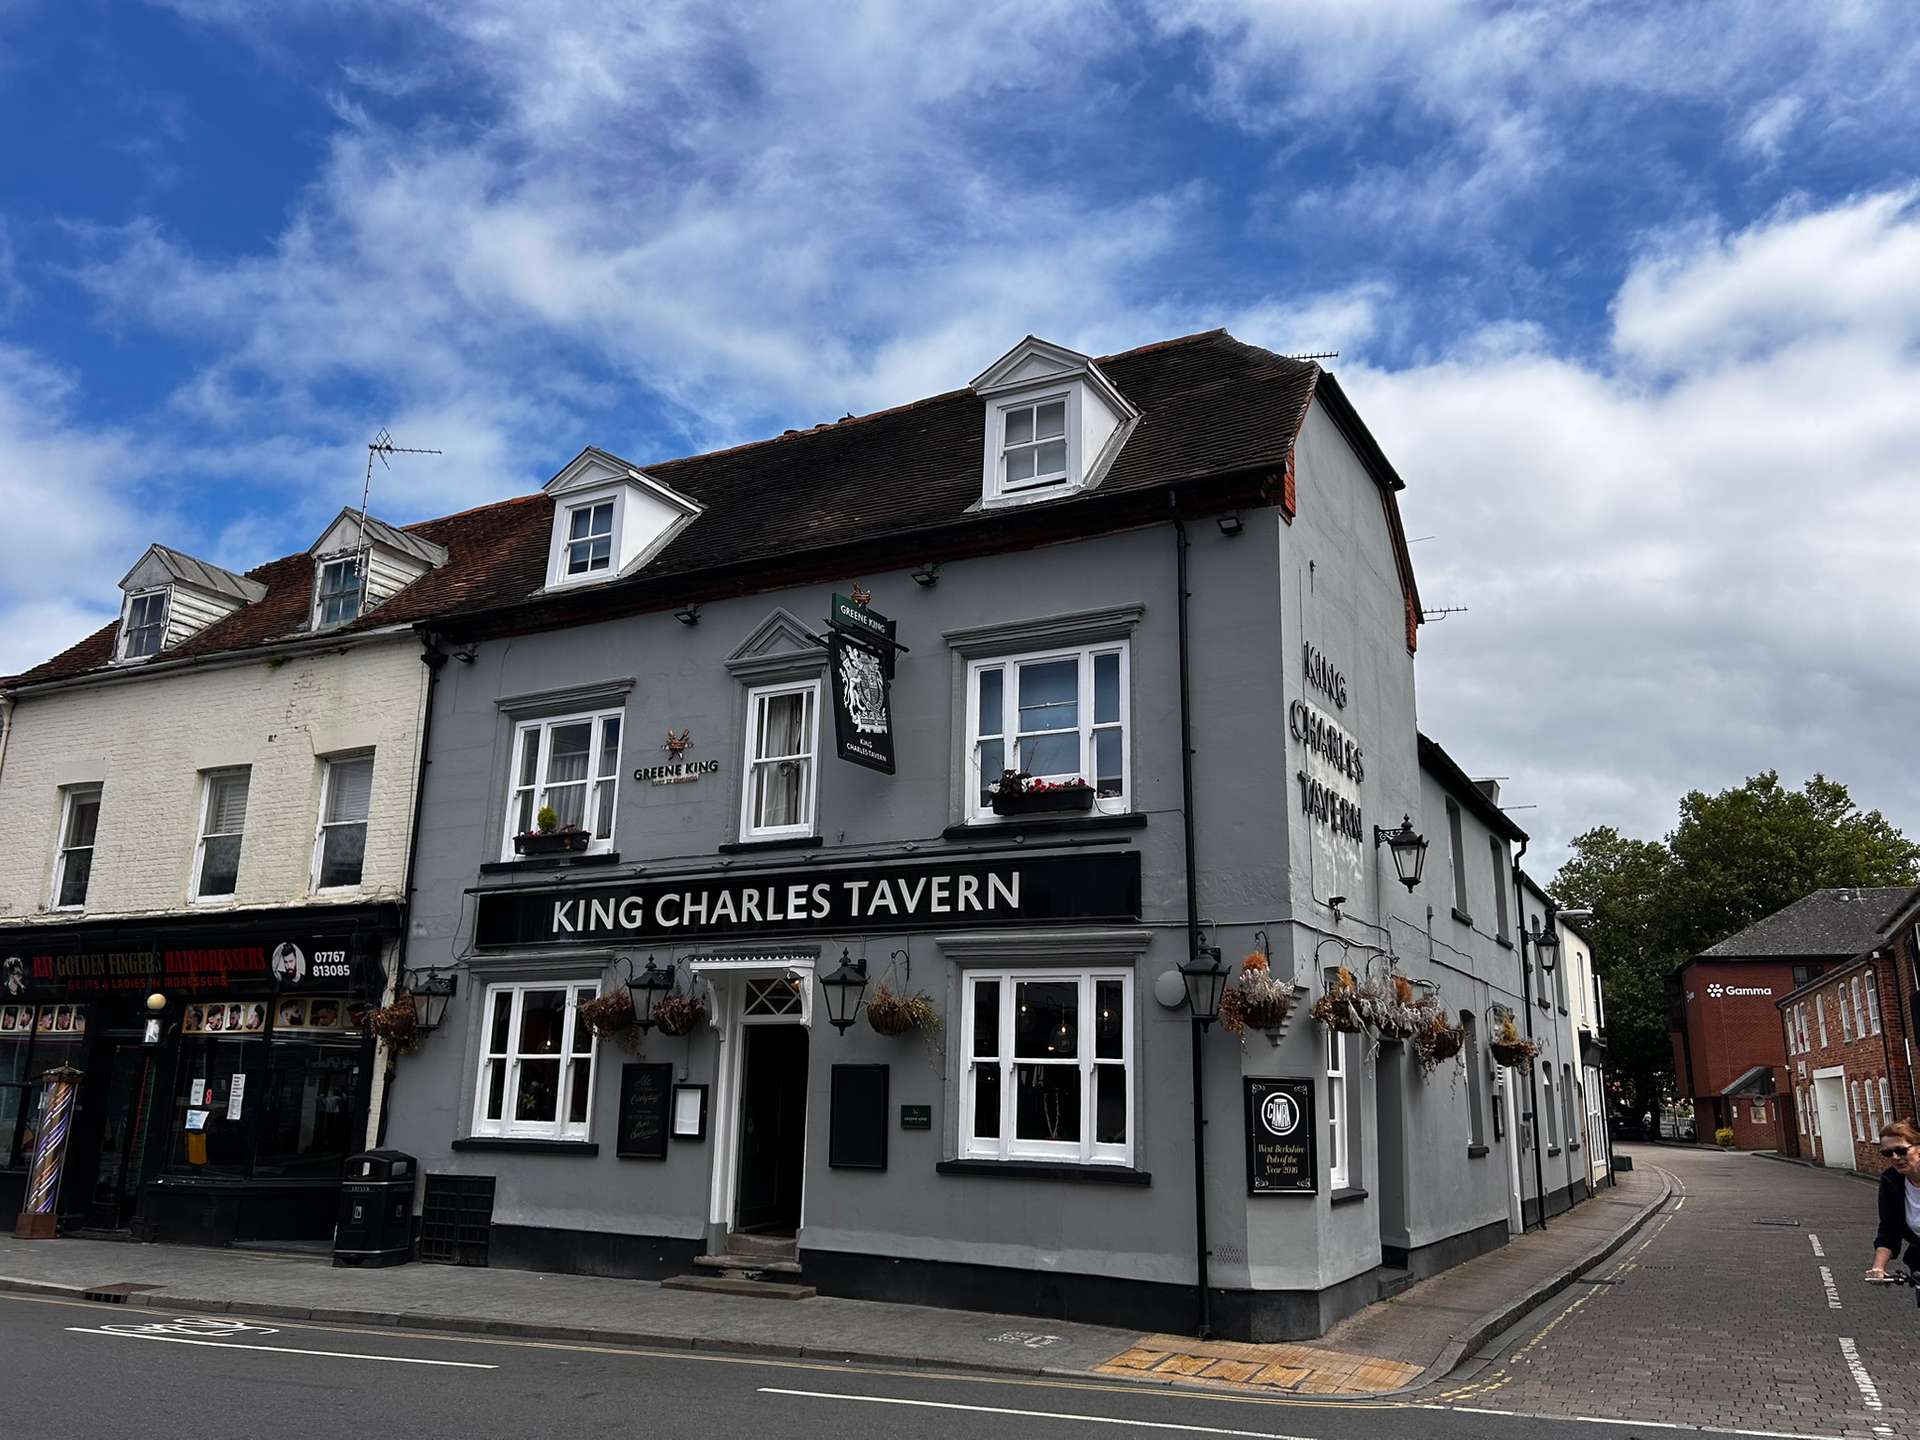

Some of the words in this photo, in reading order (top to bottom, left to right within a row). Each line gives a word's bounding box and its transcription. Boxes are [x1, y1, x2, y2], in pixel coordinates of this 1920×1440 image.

[840, 605, 868, 625] GREENE
[868, 618, 886, 634] KING
[1304, 640, 1347, 711] KING
[860, 738, 873, 748] KING
[1290, 699, 1364, 785] CHARLES
[846, 742, 868, 758] CHARLES
[868, 750, 887, 762] TAVERN
[634, 765, 681, 780] GREENE
[685, 760, 719, 774] KING
[1297, 769, 1364, 846] TAVERN
[552, 896, 643, 933] KING
[655, 883, 831, 927] CHARLES
[844, 871, 1020, 917] TAVERN
[56, 954, 105, 976] GOLDEN
[164, 947, 266, 972] HAIRDRESSERS
[314, 950, 346, 963] 07767
[312, 964, 351, 977] 813085
[111, 978, 146, 989] LADIES
[1725, 986, 1772, 996] Gamma
[1258, 1144, 1273, 1153] West
[1275, 1144, 1305, 1153] Berkshire
[1266, 1154, 1279, 1163] Pub
[1280, 1154, 1288, 1166] of
[1265, 1166, 1281, 1175] Year
